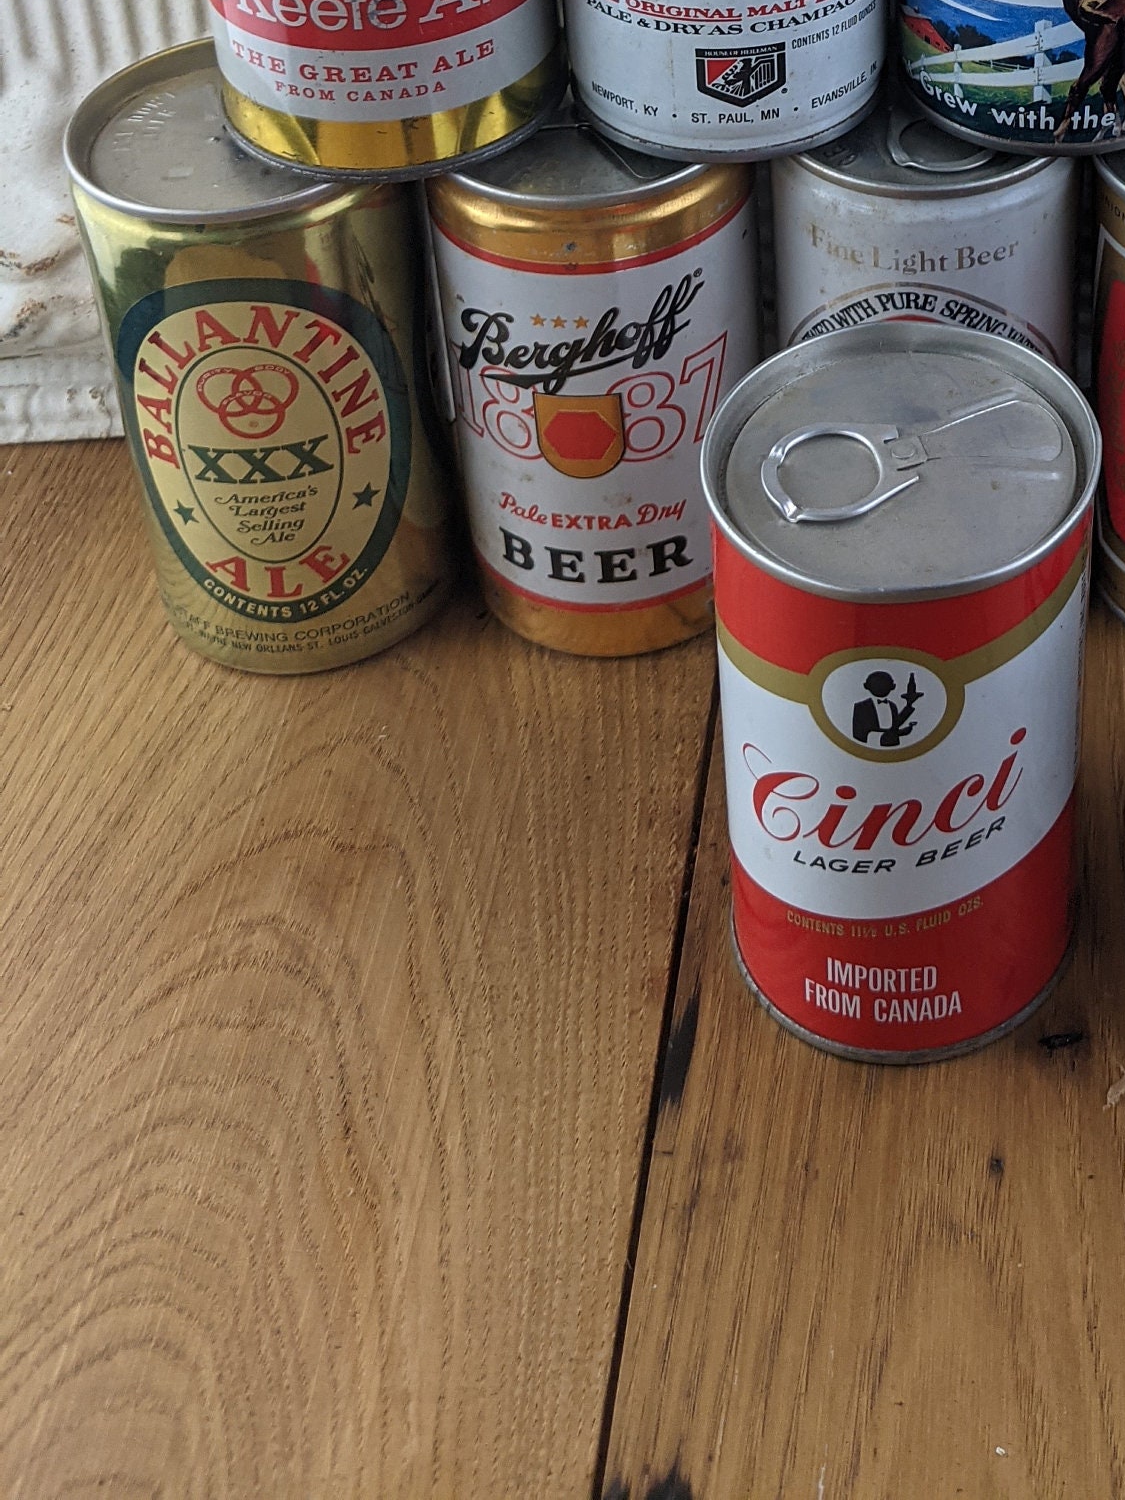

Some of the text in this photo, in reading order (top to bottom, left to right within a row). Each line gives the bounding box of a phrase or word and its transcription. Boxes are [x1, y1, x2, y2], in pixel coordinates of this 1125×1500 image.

[653, 19, 702, 34] DRY
[708, 23, 743, 35] AS
[791, 30, 829, 50] CONTENTS
[232, 39, 496, 84] THE GREAT ALE
[275, 81, 446, 102] FROM CANADA
[592, 82, 659, 117] NEWPORT, KY
[920, 71, 977, 116] Grew
[991, 107, 1054, 130] with
[1070, 105, 1115, 130] the
[691, 108, 780, 124] ST. PAUL, MN
[809, 223, 1019, 275] Fine Light Beer
[461, 273, 705, 394] Berghoff
[830, 291, 1006, 339] WITH PURE SPRING
[137, 305, 387, 469] BALLANTINE
[452, 330, 728, 462] 1887
[187, 434, 334, 484] XXX
[214, 485, 319, 505] America's
[229, 502, 306, 518] Largest
[500, 491, 687, 530] Pale EXTRA Dry
[237, 518, 305, 533] Selling
[250, 531, 296, 545] Ale
[206, 545, 351, 598] ALE
[500, 526, 694, 584] BEER
[203, 579, 292, 618] CONTENTS
[300, 601, 319, 613] 12
[216, 625, 288, 642] BREWING
[293, 591, 411, 641] CORPORATION
[743, 727, 1027, 851] Cinci
[793, 816, 1006, 874] LAGER BEER
[787, 910, 950, 937] CONTENTS U.S. FLUID
[826, 956, 938, 993] IMPORTED
[805, 978, 962, 1023] FROM CANADA
